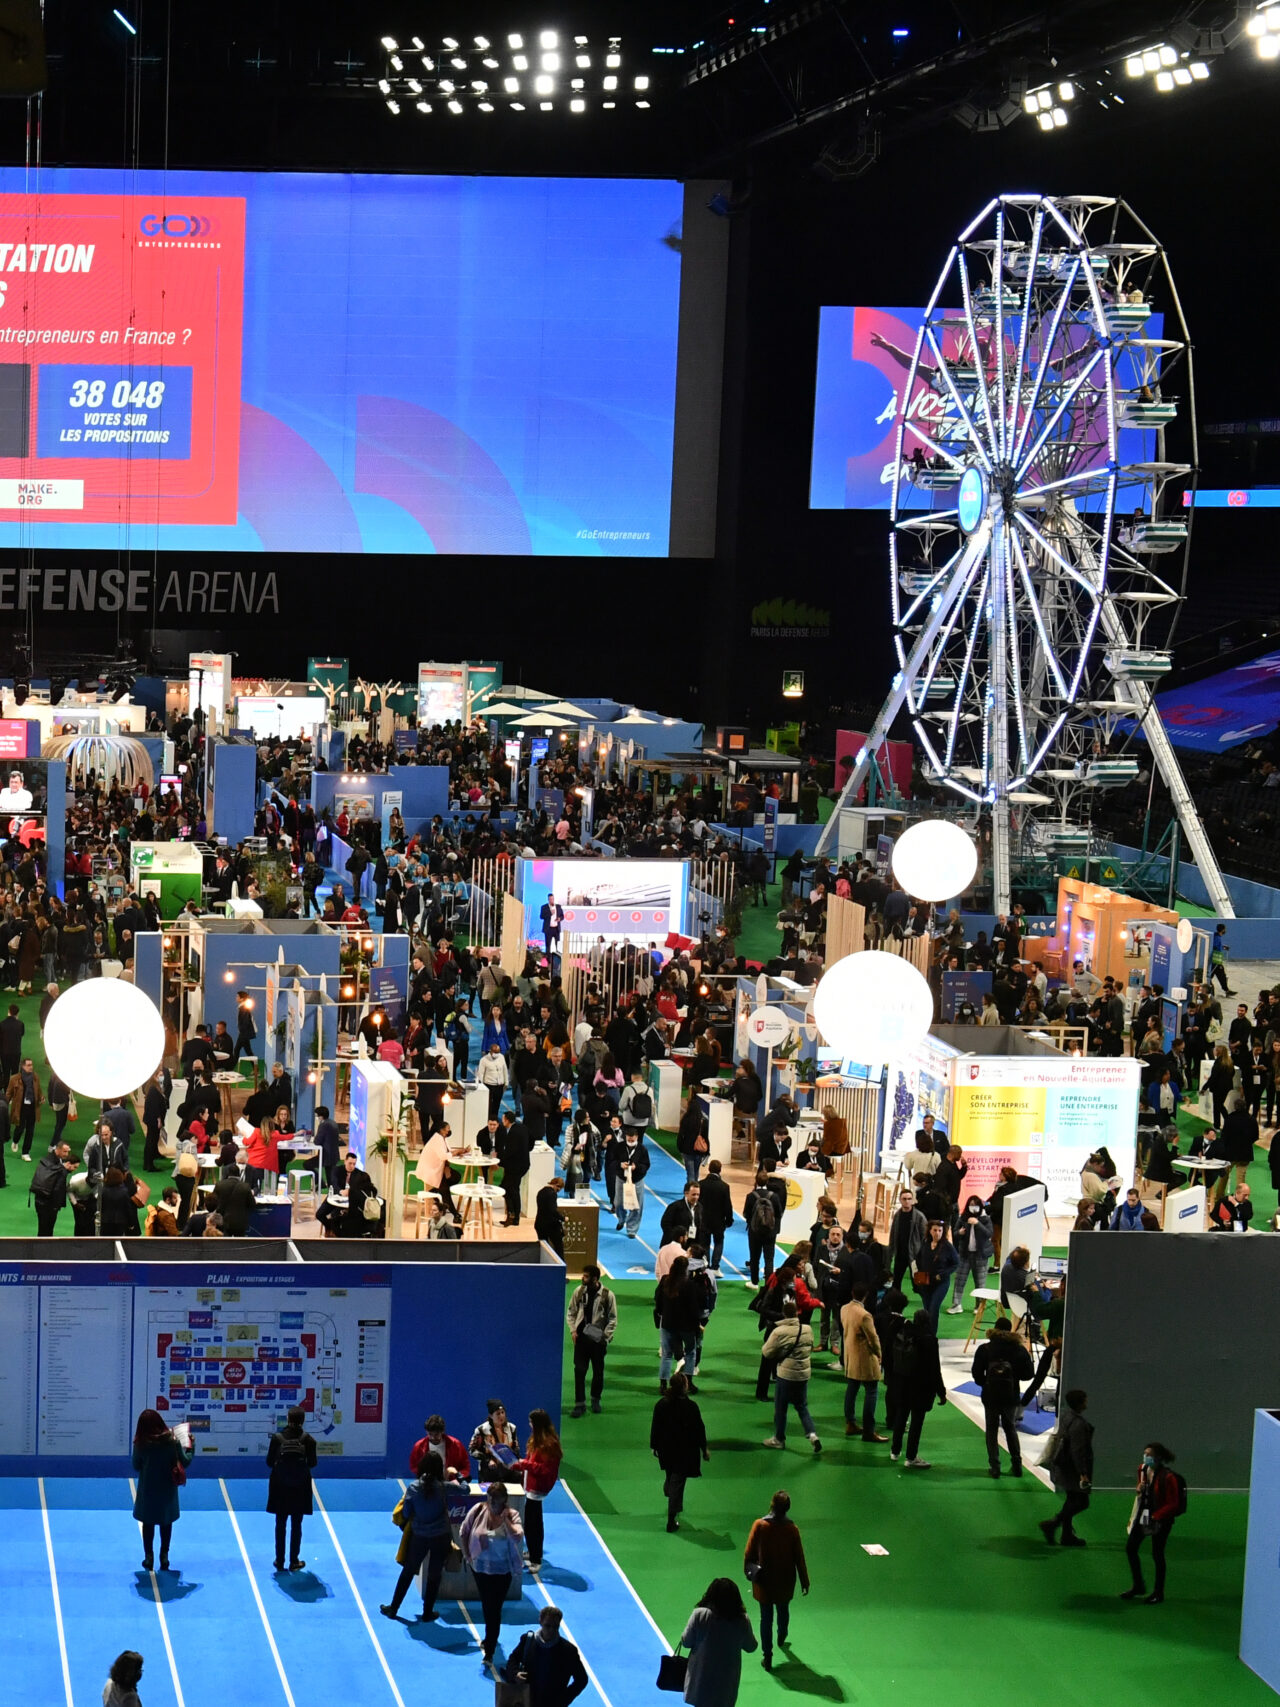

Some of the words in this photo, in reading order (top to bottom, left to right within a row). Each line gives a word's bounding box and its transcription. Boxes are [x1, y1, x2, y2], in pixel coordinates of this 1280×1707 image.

[138, 241, 221, 249] ENTREPRENEURS
[100, 331, 119, 343] en
[123, 327, 176, 345] France
[181, 328, 192, 345] ?
[69, 379, 106, 408] 38
[111, 380, 165, 409] 048
[84, 413, 121, 426] VOTES
[123, 413, 147, 426] SUR
[60, 429, 82, 442] LES
[84, 430, 170, 444] PROPOSITIONS
[18, 495, 42, 505] ORG
[576, 529, 650, 541] #GoEntrepreneurs
[159, 571, 279, 614] ARENA
[1071, 1065, 1127, 1074] Entreprenez
[206, 1274, 231, 1284] PLAN
